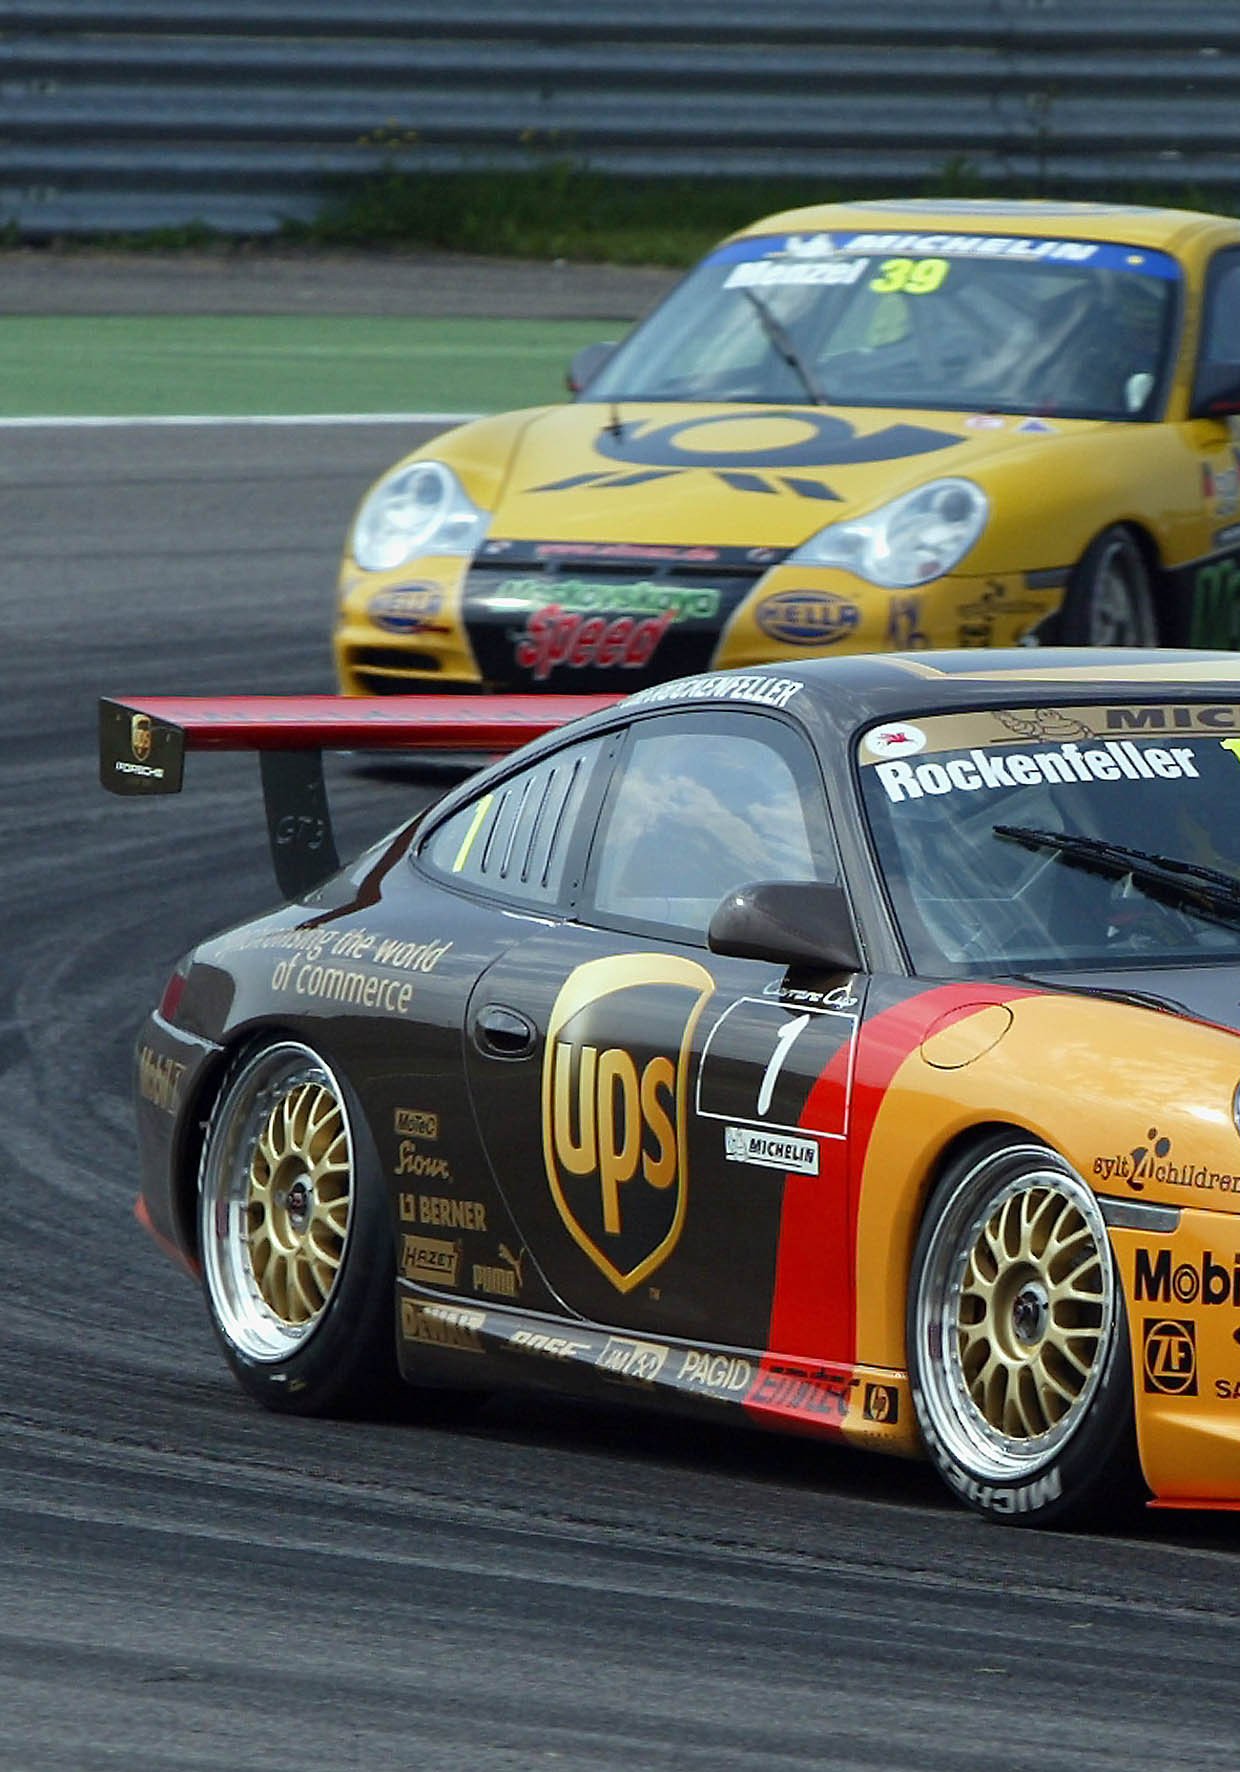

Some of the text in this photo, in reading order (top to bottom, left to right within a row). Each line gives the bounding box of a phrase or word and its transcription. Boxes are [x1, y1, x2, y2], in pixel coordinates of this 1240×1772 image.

[843, 234, 1099, 261] MICHELIN
[869, 258, 950, 294] 39
[515, 602, 679, 681] Speed
[875, 740, 1200, 803] Rockenfeller
[331, 927, 376, 959] the
[373, 937, 454, 973] world
[271, 951, 413, 1014] of commerce
[757, 1013, 811, 1117] 1
[554, 1041, 678, 1235] ups
[747, 1136, 815, 1165] MICHELIN
[419, 1194, 488, 1232] BERNER
[405, 1246, 456, 1270] HAZET
[677, 1350, 751, 1392] PAGID
[1151, 1334, 1193, 1377] ZF
